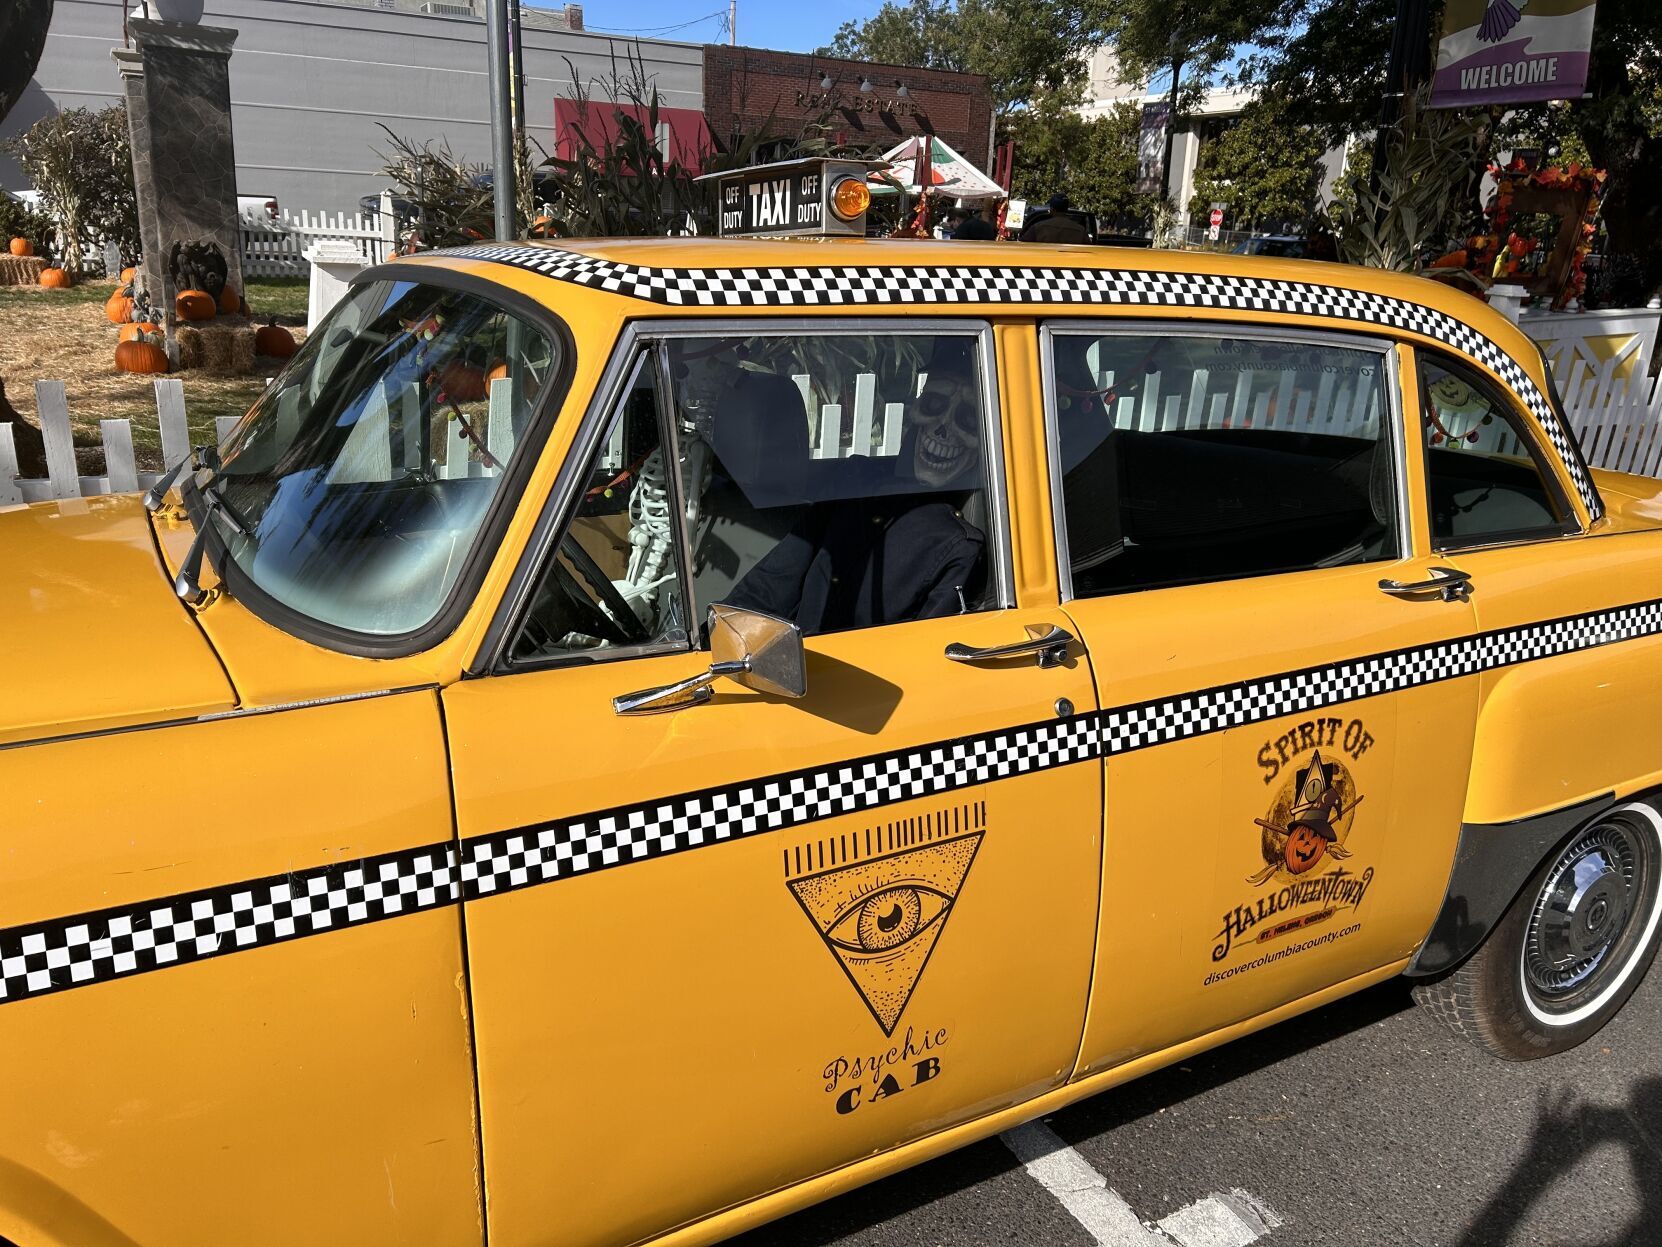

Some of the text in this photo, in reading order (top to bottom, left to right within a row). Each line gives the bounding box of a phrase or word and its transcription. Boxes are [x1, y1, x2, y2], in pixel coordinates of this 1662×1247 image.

[1460, 57, 1558, 90] WELCOME
[853, 97, 919, 116] ESTATE
[725, 186, 740, 205] OFF
[801, 174, 818, 196] OFF
[748, 178, 791, 228] TAXI
[797, 202, 822, 223] DUTY
[723, 210, 743, 230] DUTY
[1210, 213, 1223, 222] STOP
[1256, 717, 1375, 785] SPIRIT OF
[1203, 922, 1361, 987] discovercolumbiacounty.com
[822, 1025, 949, 1093] Psychic
[835, 1056, 941, 1115] CAB
